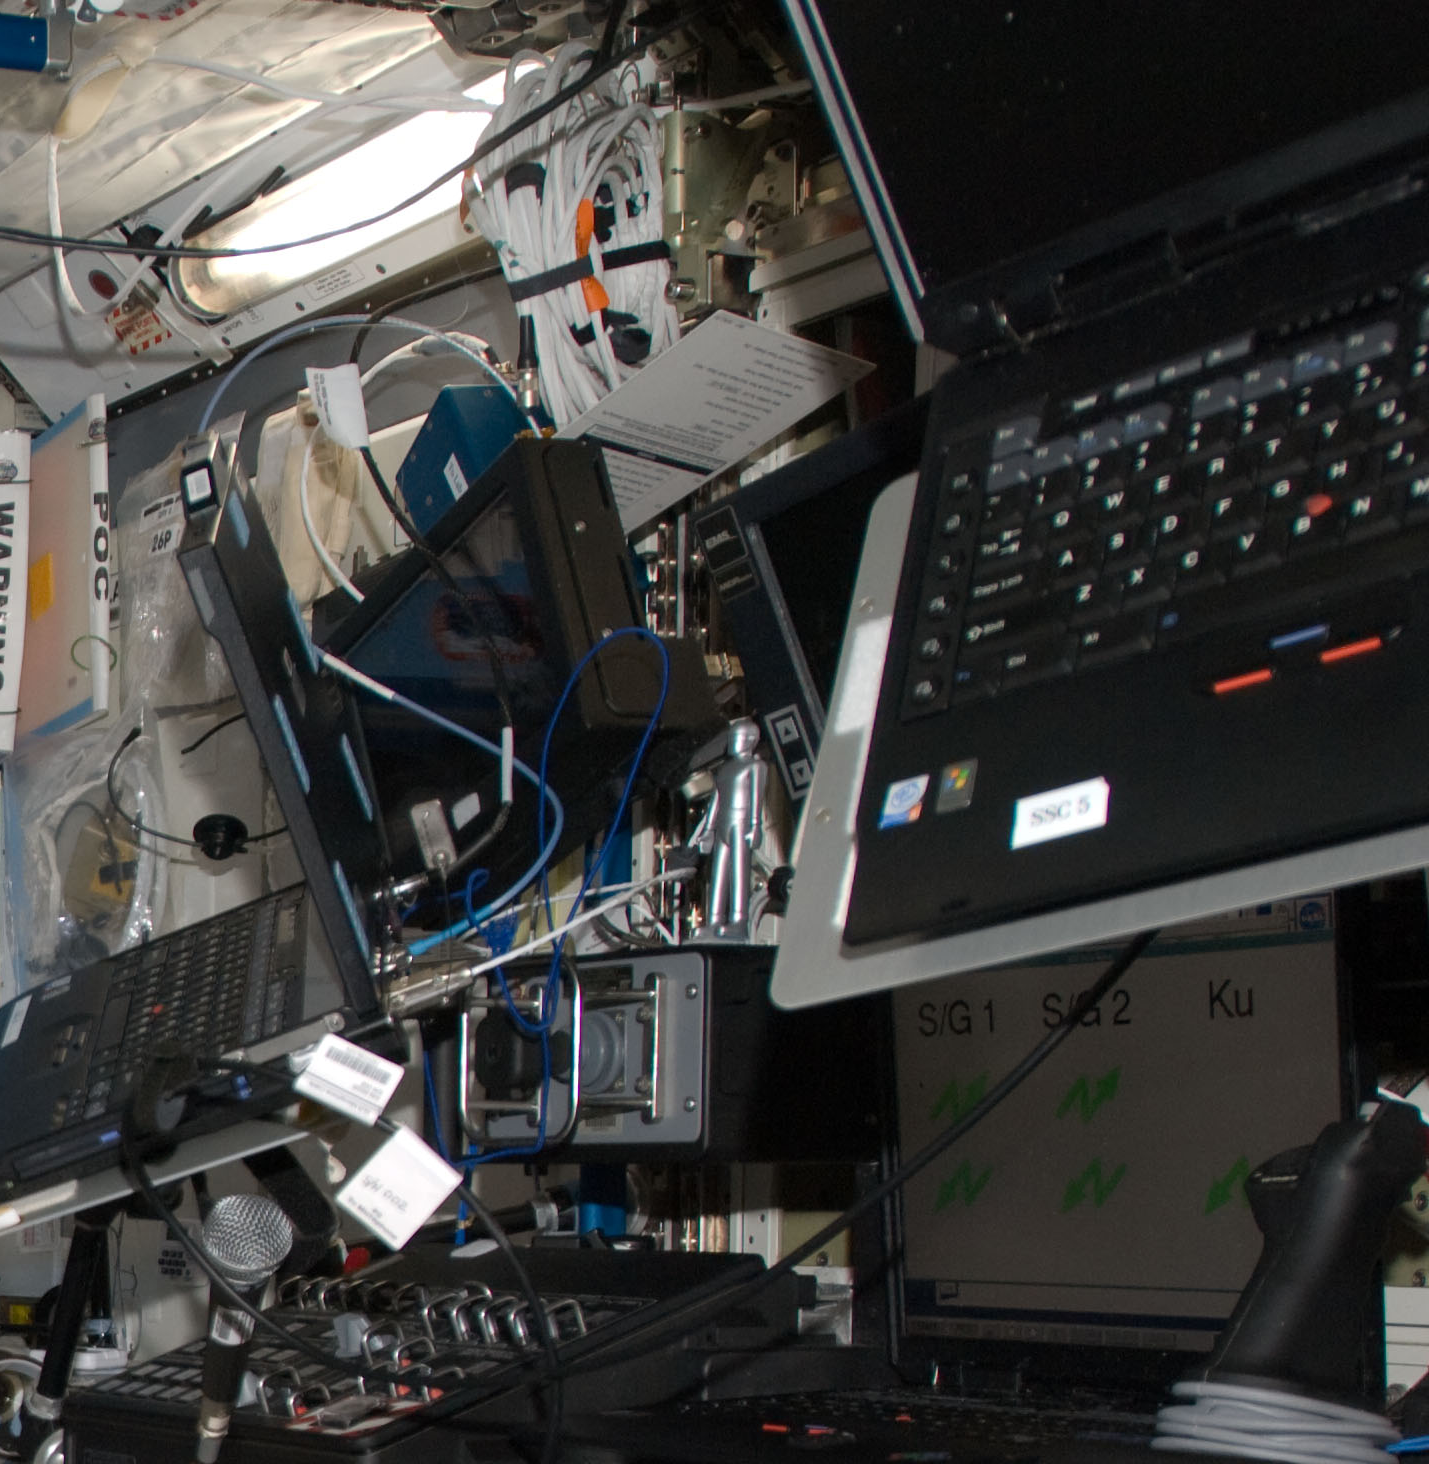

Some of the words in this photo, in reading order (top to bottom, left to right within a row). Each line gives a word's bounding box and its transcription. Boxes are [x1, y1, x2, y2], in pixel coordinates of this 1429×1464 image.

[92, 491, 109, 602] POC
[1029, 799, 1072, 828] SSC
[1077, 794, 1091, 816] 5
[917, 1000, 973, 1038] S/G
[983, 1001, 996, 1034] 1
[1112, 989, 1132, 1026] 2
[1208, 980, 1255, 1021] Ku
